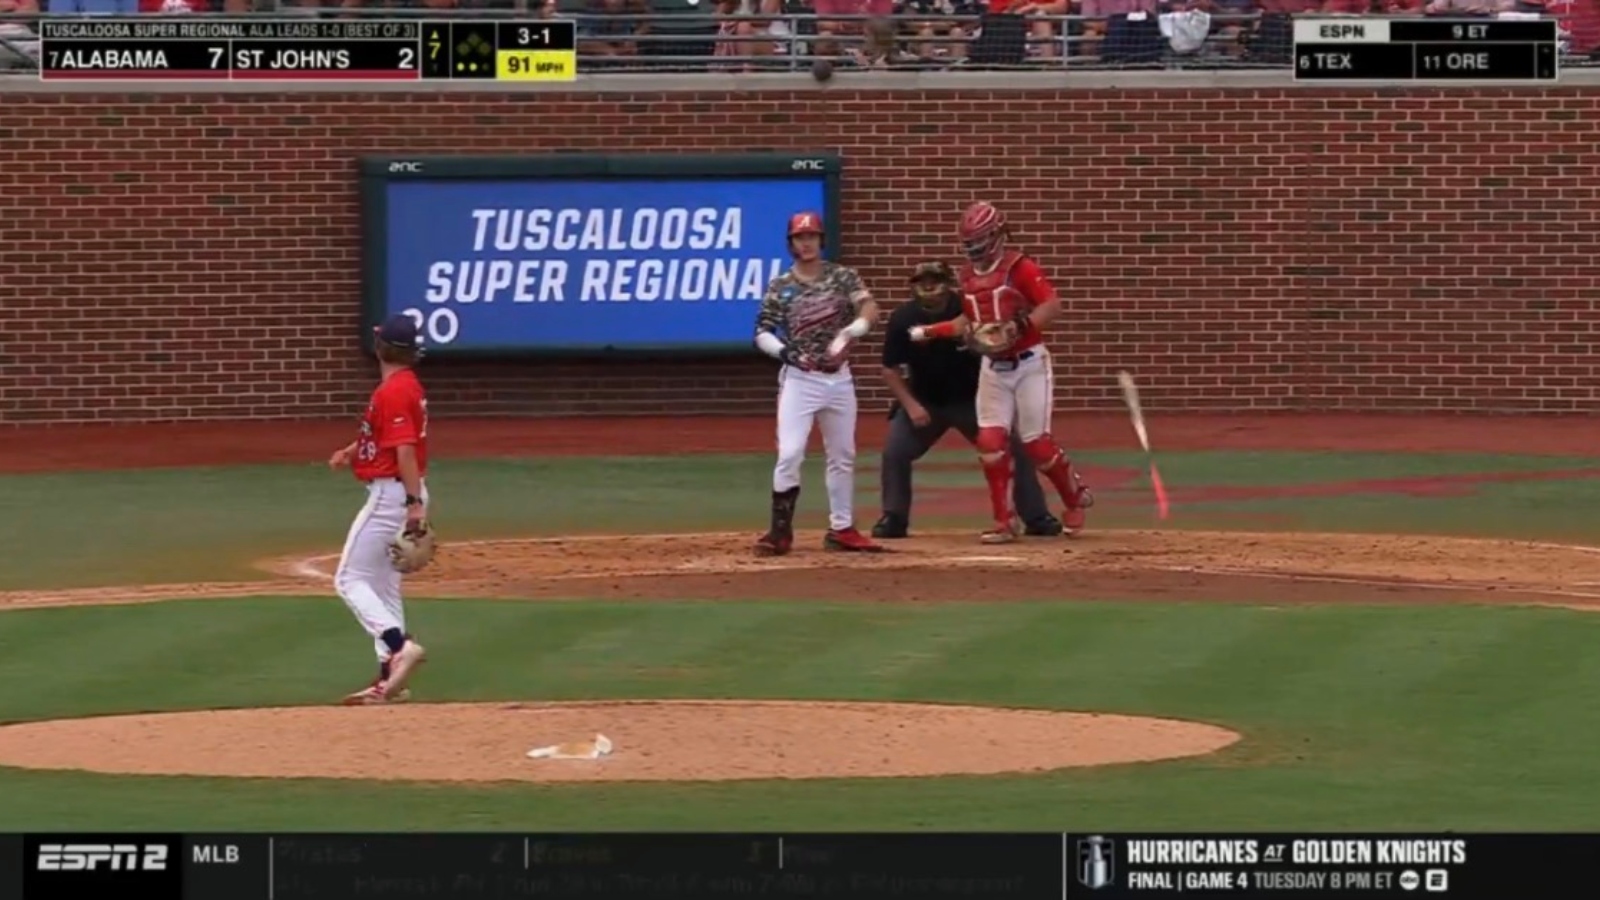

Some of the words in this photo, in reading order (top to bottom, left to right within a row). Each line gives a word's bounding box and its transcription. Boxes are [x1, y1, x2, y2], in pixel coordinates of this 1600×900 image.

[472, 207, 742, 252] TUSCALOOSA
[797, 215, 812, 228] A
[425, 259, 566, 304] SUPER
